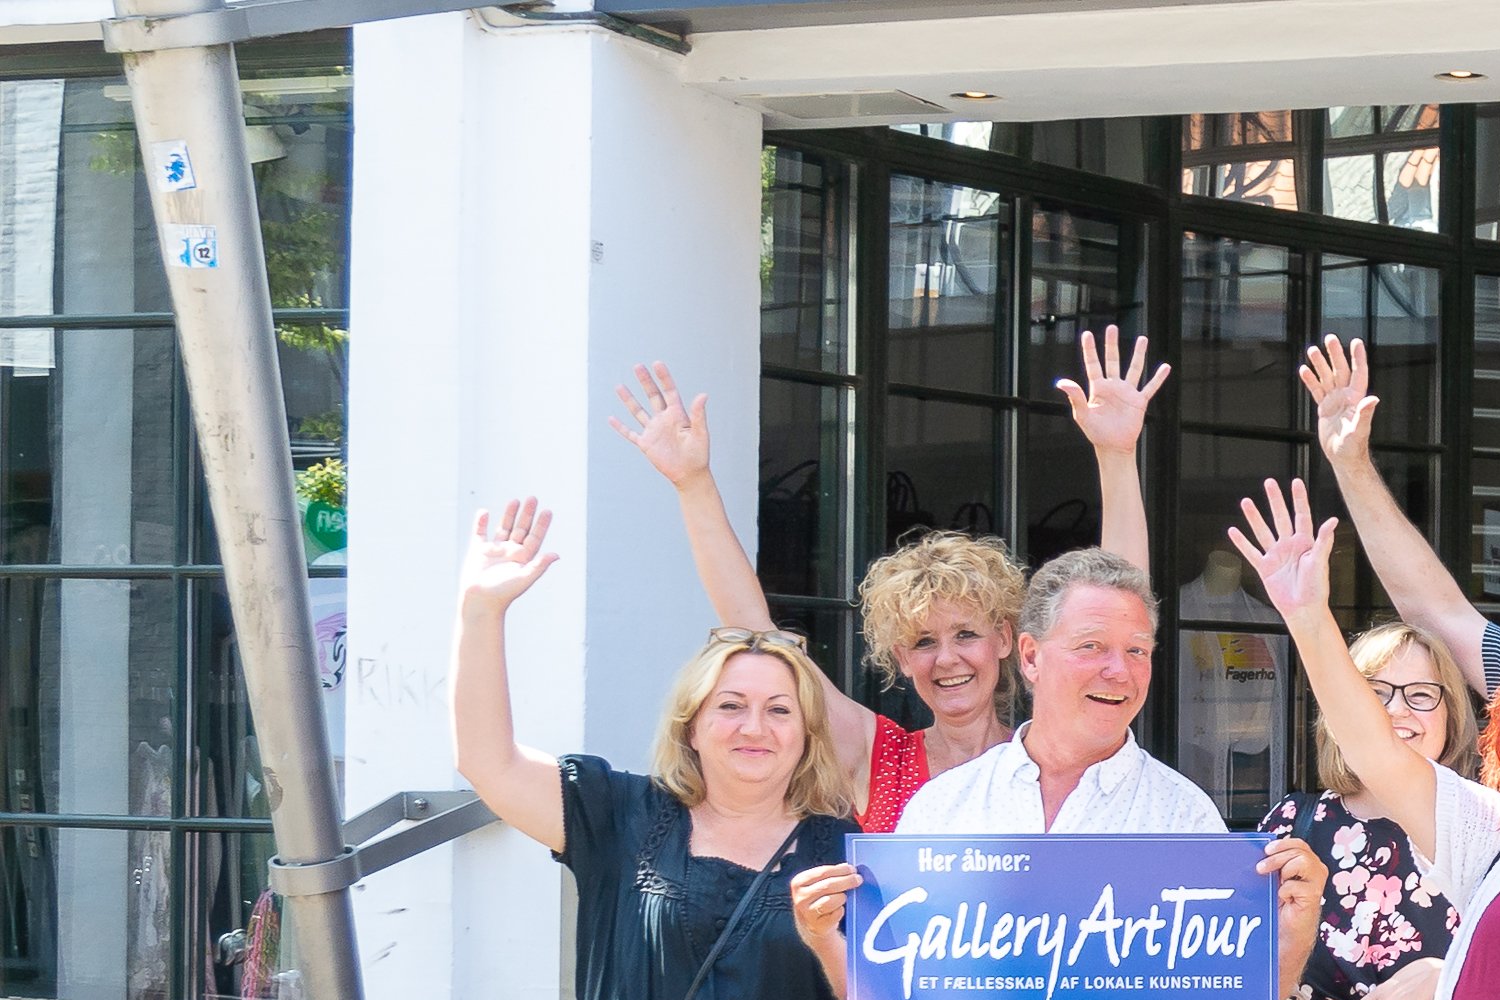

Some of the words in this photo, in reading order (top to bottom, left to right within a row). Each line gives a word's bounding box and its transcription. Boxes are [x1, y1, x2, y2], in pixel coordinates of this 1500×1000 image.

[1225, 666, 1276, 683] Fagerho
[918, 847, 956, 872] Her
[961, 847, 1031, 872] åbner:
[919, 976, 940, 989] ET
[944, 976, 1045, 989] FÆLLESSKAB
[1060, 976, 1080, 989] AF
[1084, 976, 1144, 989] LOKALE
[1149, 976, 1243, 989] KUNSTNERE
